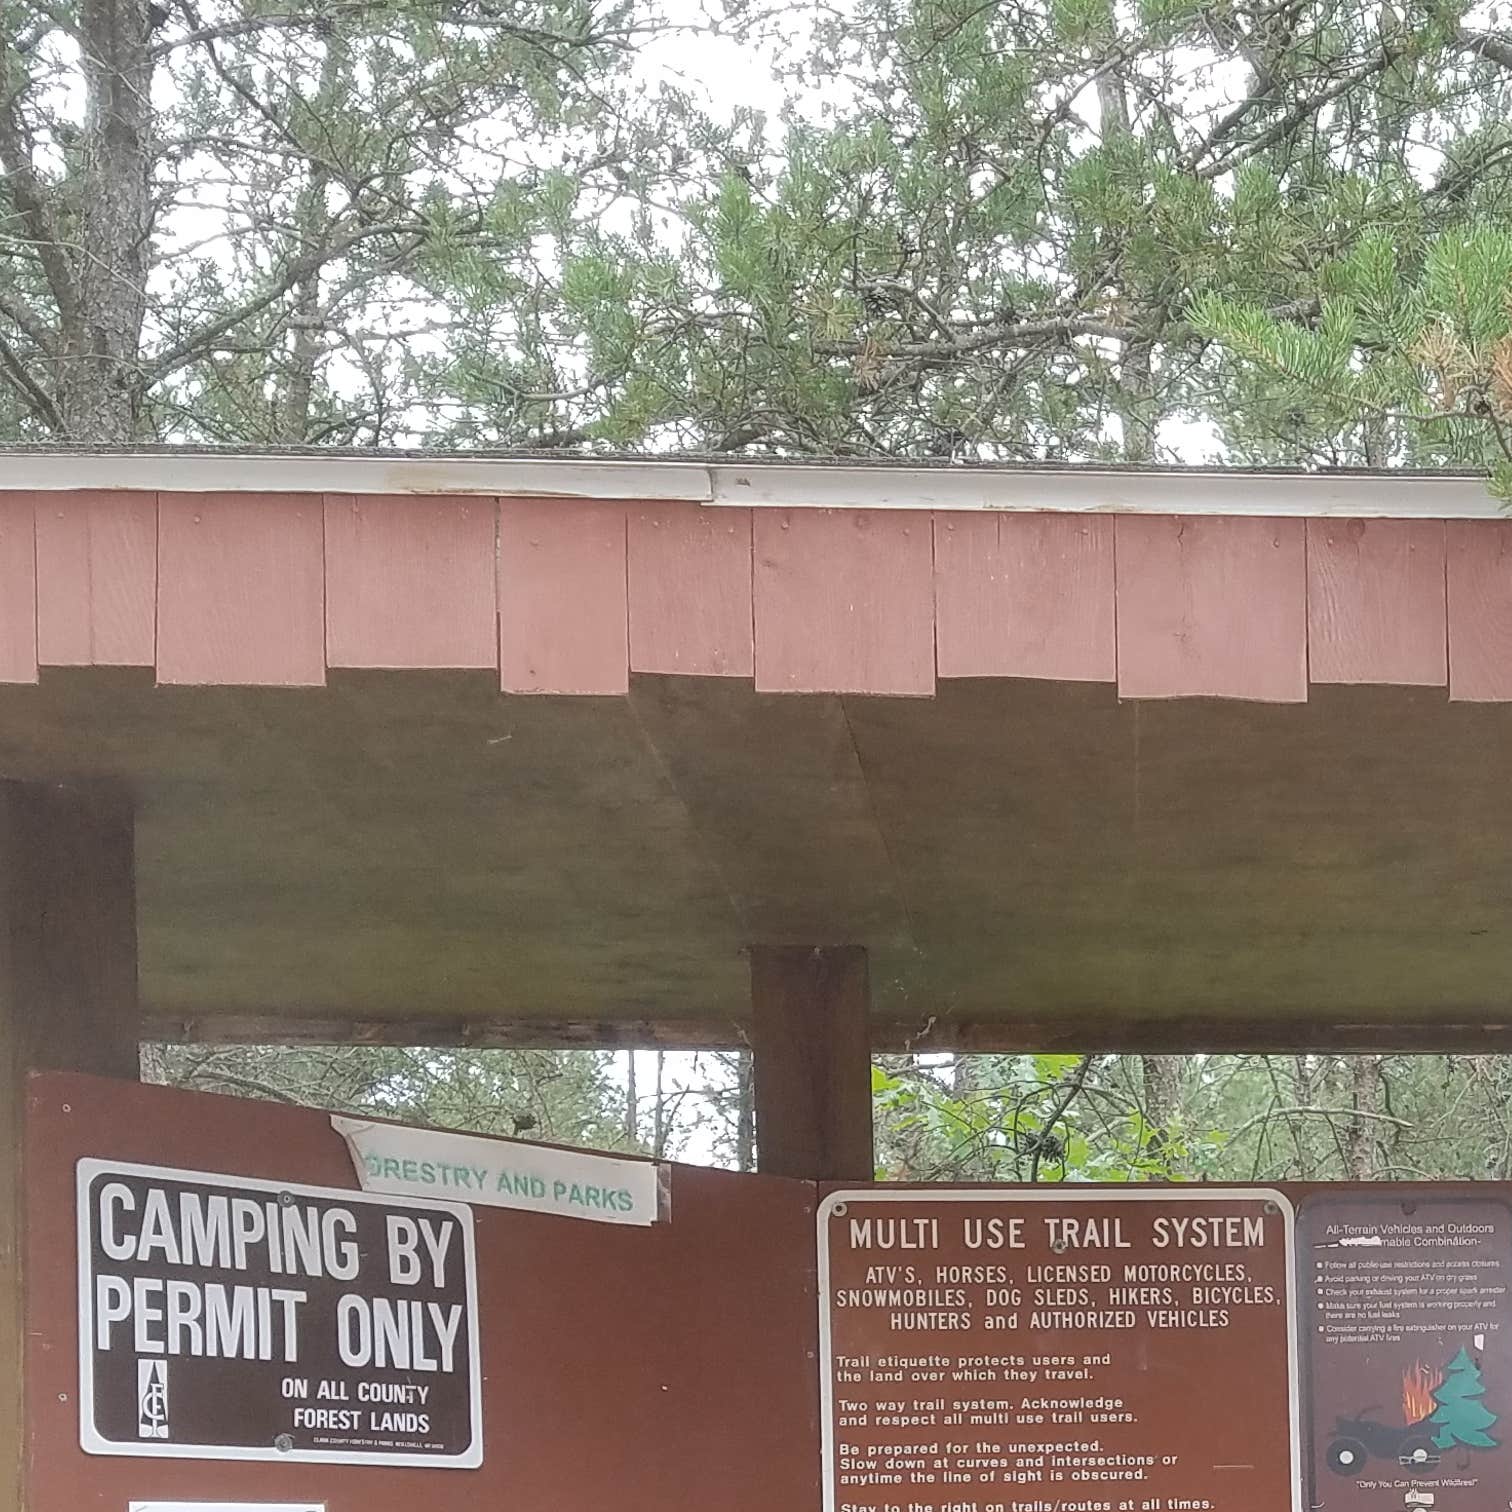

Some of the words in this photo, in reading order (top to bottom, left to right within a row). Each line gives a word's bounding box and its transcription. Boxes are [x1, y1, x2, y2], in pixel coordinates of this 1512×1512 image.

[496, 1169, 546, 1198] AND
[552, 1178, 633, 1211] PARKS
[99, 1182, 358, 1280] CAMPING
[385, 1214, 453, 1288] BY
[849, 1218, 938, 1249] MULTI
[964, 1217, 1025, 1249] USE
[1044, 1217, 1131, 1249] TRAIL
[1152, 1216, 1264, 1248] SYSTEM
[1325, 1223, 1379, 1235] All-Terrain
[1379, 1223, 1423, 1235] Vehicles
[1424, 1223, 1447, 1235] and
[1446, 1223, 1495, 1234] Outdoors
[865, 1265, 922, 1286] ATV'S,
[935, 1265, 1013, 1285] HORSES,
[1027, 1264, 1111, 1283] LICENSED
[1123, 1263, 1252, 1283] MOTORCYCLES,
[836, 1288, 972, 1308] SNOWMOBILES,
[986, 1288, 1021, 1306] DOG
[1033, 1287, 1096, 1308] SLEDS,
[1108, 1287, 1179, 1307] HIKERS,
[1192, 1285, 1281, 1306] BICYCLES,
[97, 1275, 306, 1362] PERMIT
[336, 1293, 462, 1373] ONLY
[890, 1311, 971, 1330] HUNTERS
[983, 1311, 1017, 1330] and
[1029, 1310, 1136, 1329] AUTHORIZED
[1146, 1309, 1232, 1329] VEHICLES
[835, 1355, 870, 1368] Trail
[877, 1354, 950, 1369] etiquette
[957, 1353, 1024, 1368] protects
[1031, 1356, 1075, 1365] users
[1082, 1352, 1111, 1365] and
[836, 1369, 861, 1382] the
[869, 1369, 903, 1382] land
[911, 1370, 945, 1381] over
[951, 1368, 996, 1381] which
[1003, 1368, 1037, 1382] they
[1044, 1367, 1093, 1380] travel.
[281, 1377, 308, 1399] ON
[316, 1379, 349, 1400] ALL
[357, 1381, 429, 1405] COUNTY
[293, 1407, 362, 1430] FOREST
[370, 1411, 430, 1434] LANDS
[1377, 1479, 1393, 1488] You
[1393, 1479, 1410, 1488] Can
[1410, 1479, 1440, 1488] Prevent
[984, 1503, 1004, 1512] on
[1011, 1499, 1111, 1512] trails/routes
[1118, 1499, 1134, 1511] at
[1141, 1497, 1160, 1510] all
[1167, 1497, 1215, 1510] times.
